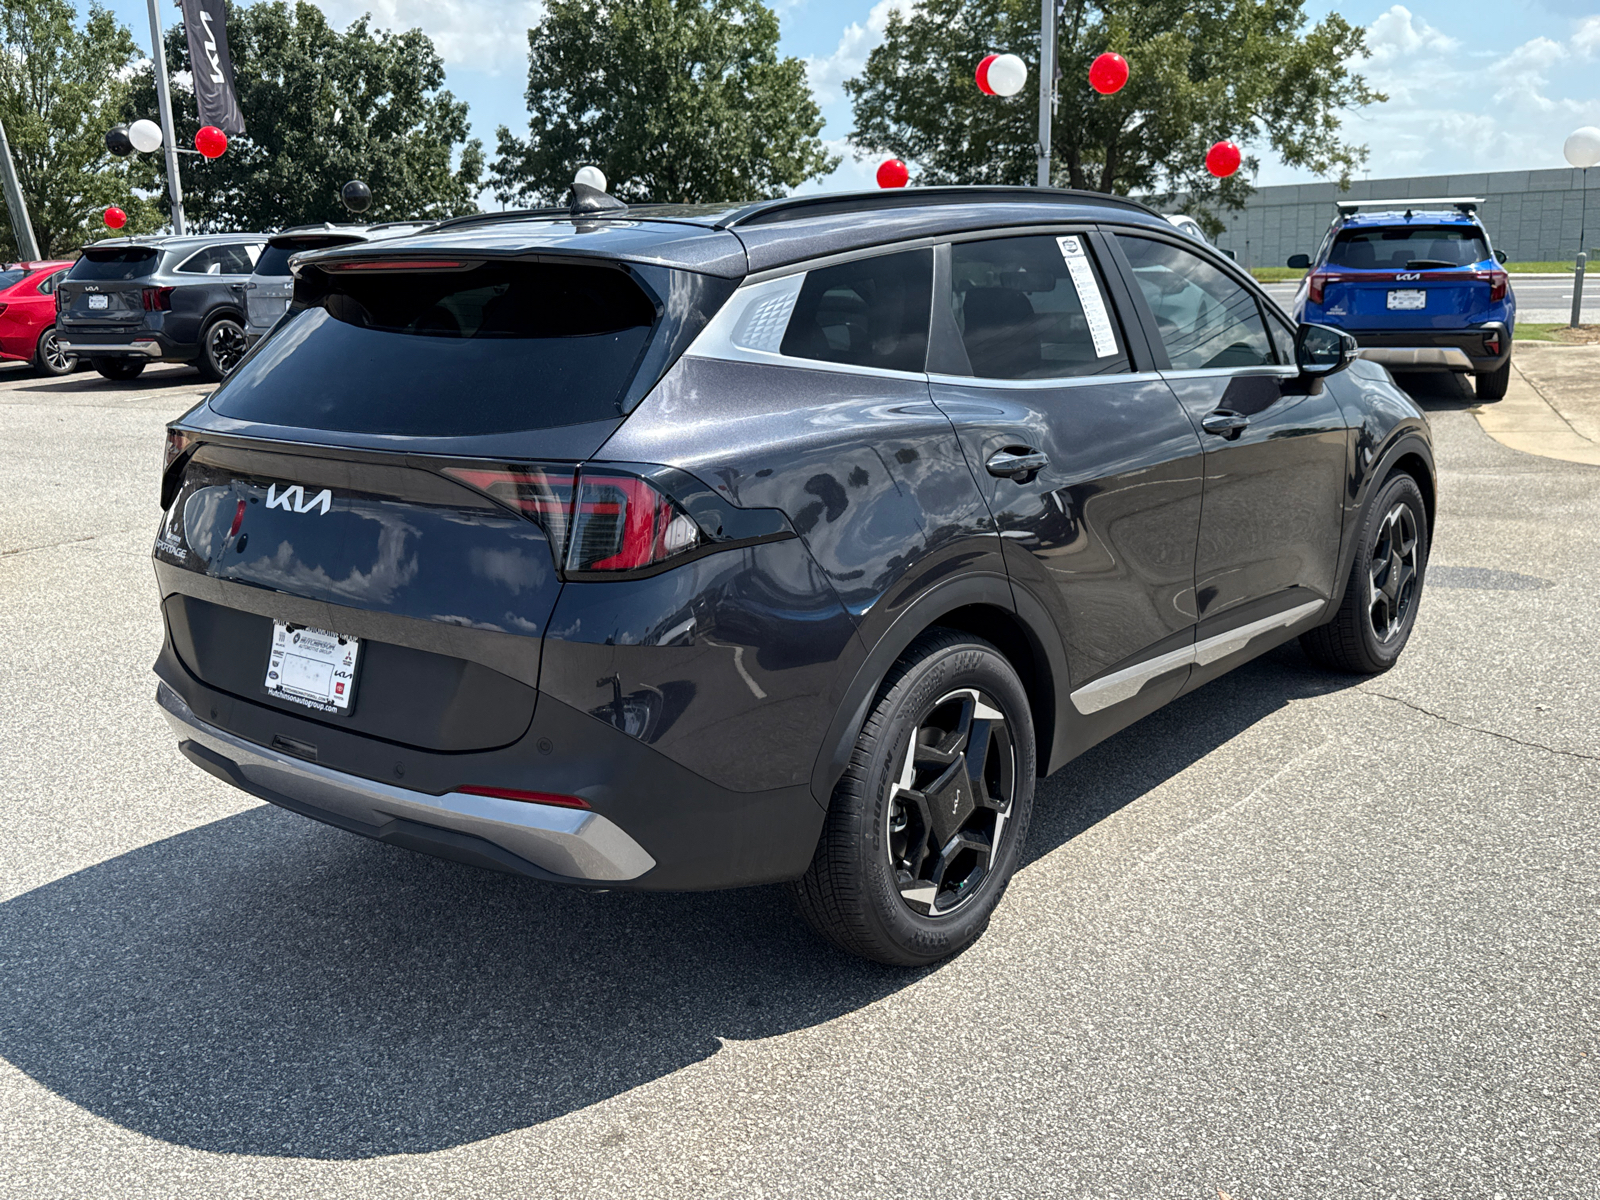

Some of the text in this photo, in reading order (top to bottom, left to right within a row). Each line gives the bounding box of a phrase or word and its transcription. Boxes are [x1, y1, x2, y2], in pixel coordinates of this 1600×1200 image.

[200, 10, 225, 83] KIA
[1396, 273, 1421, 281] KIA
[266, 483, 332, 516] KIA
[334, 670, 353, 679] KIA
[268, 689, 338, 713] Hutchinsonautogroup.com
